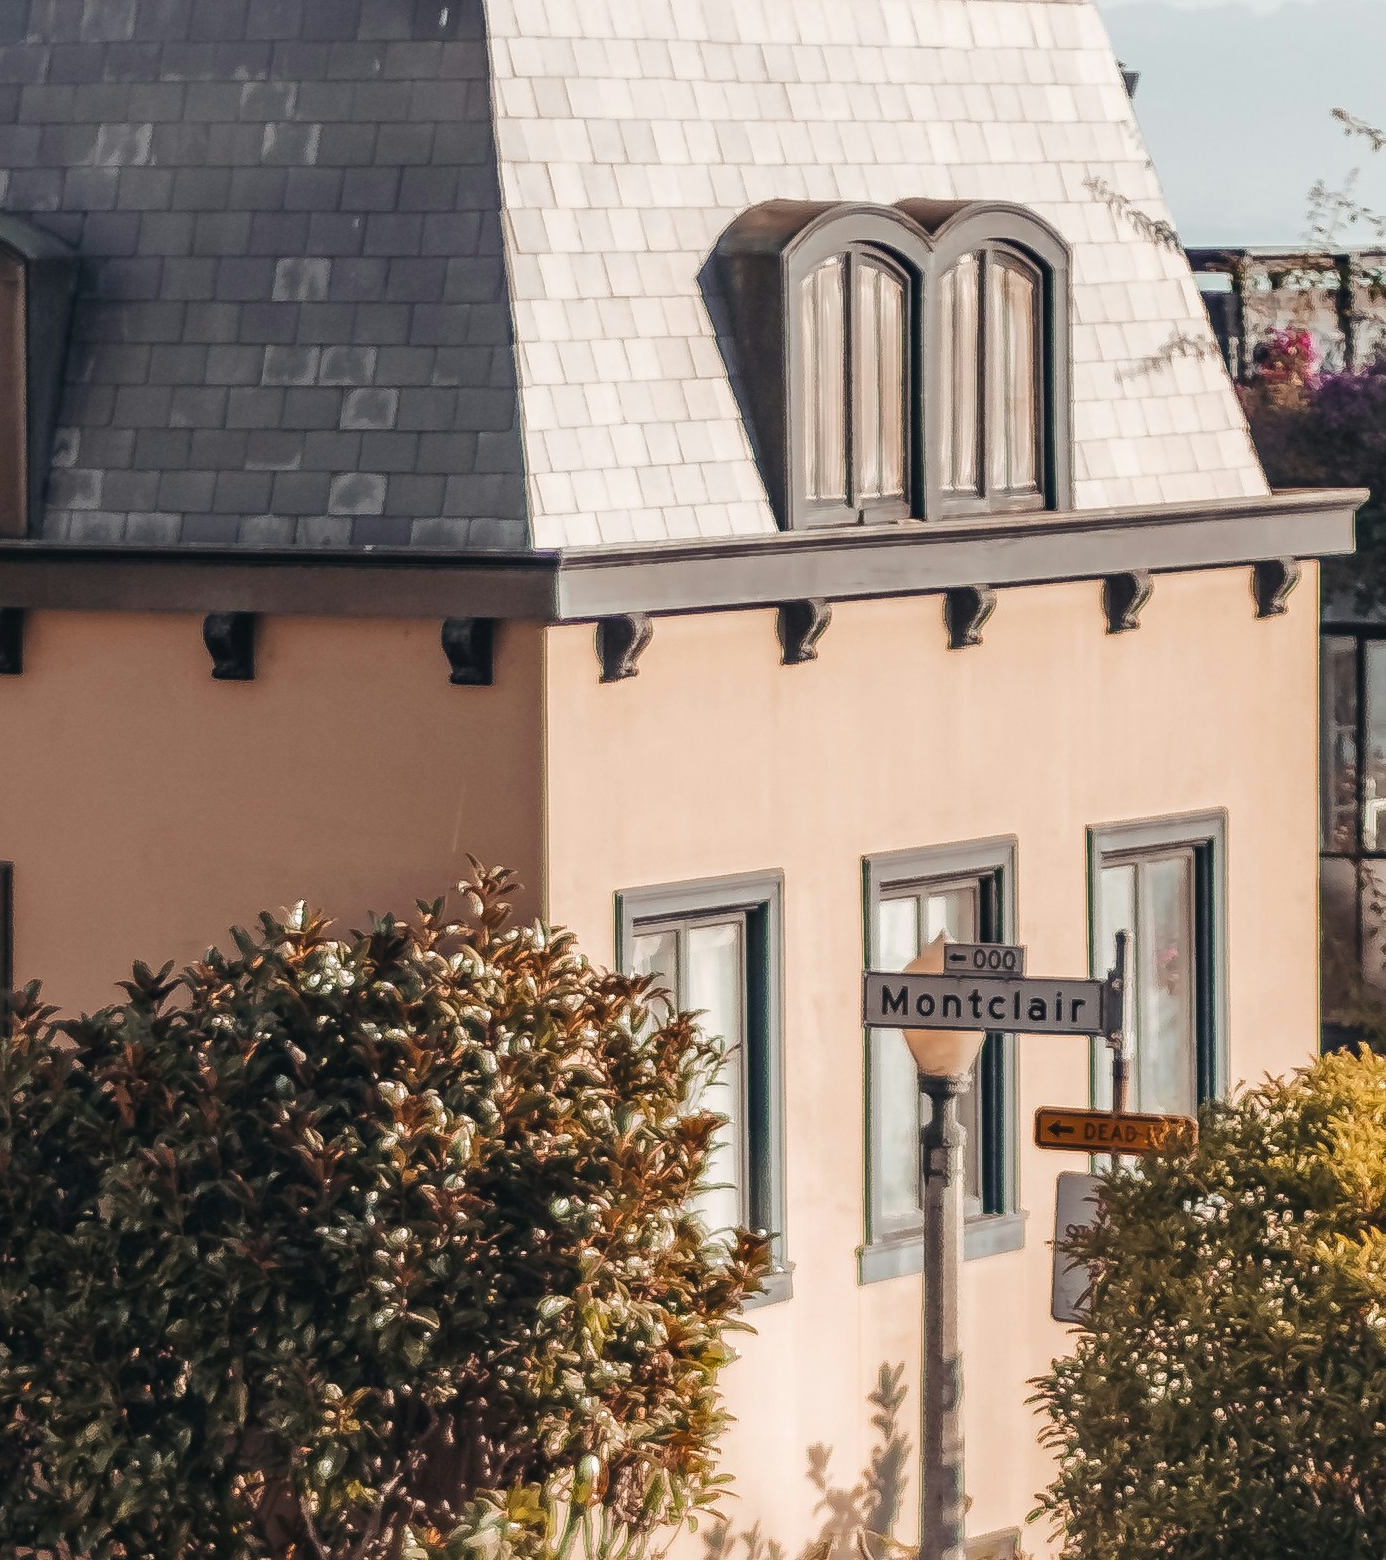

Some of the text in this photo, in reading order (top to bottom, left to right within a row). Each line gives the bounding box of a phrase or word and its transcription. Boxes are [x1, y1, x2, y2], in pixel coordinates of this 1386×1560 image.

[974, 948, 1016, 969] 000
[881, 985, 1086, 1022] Montclair
[1084, 1122, 1138, 1143] DEAD
